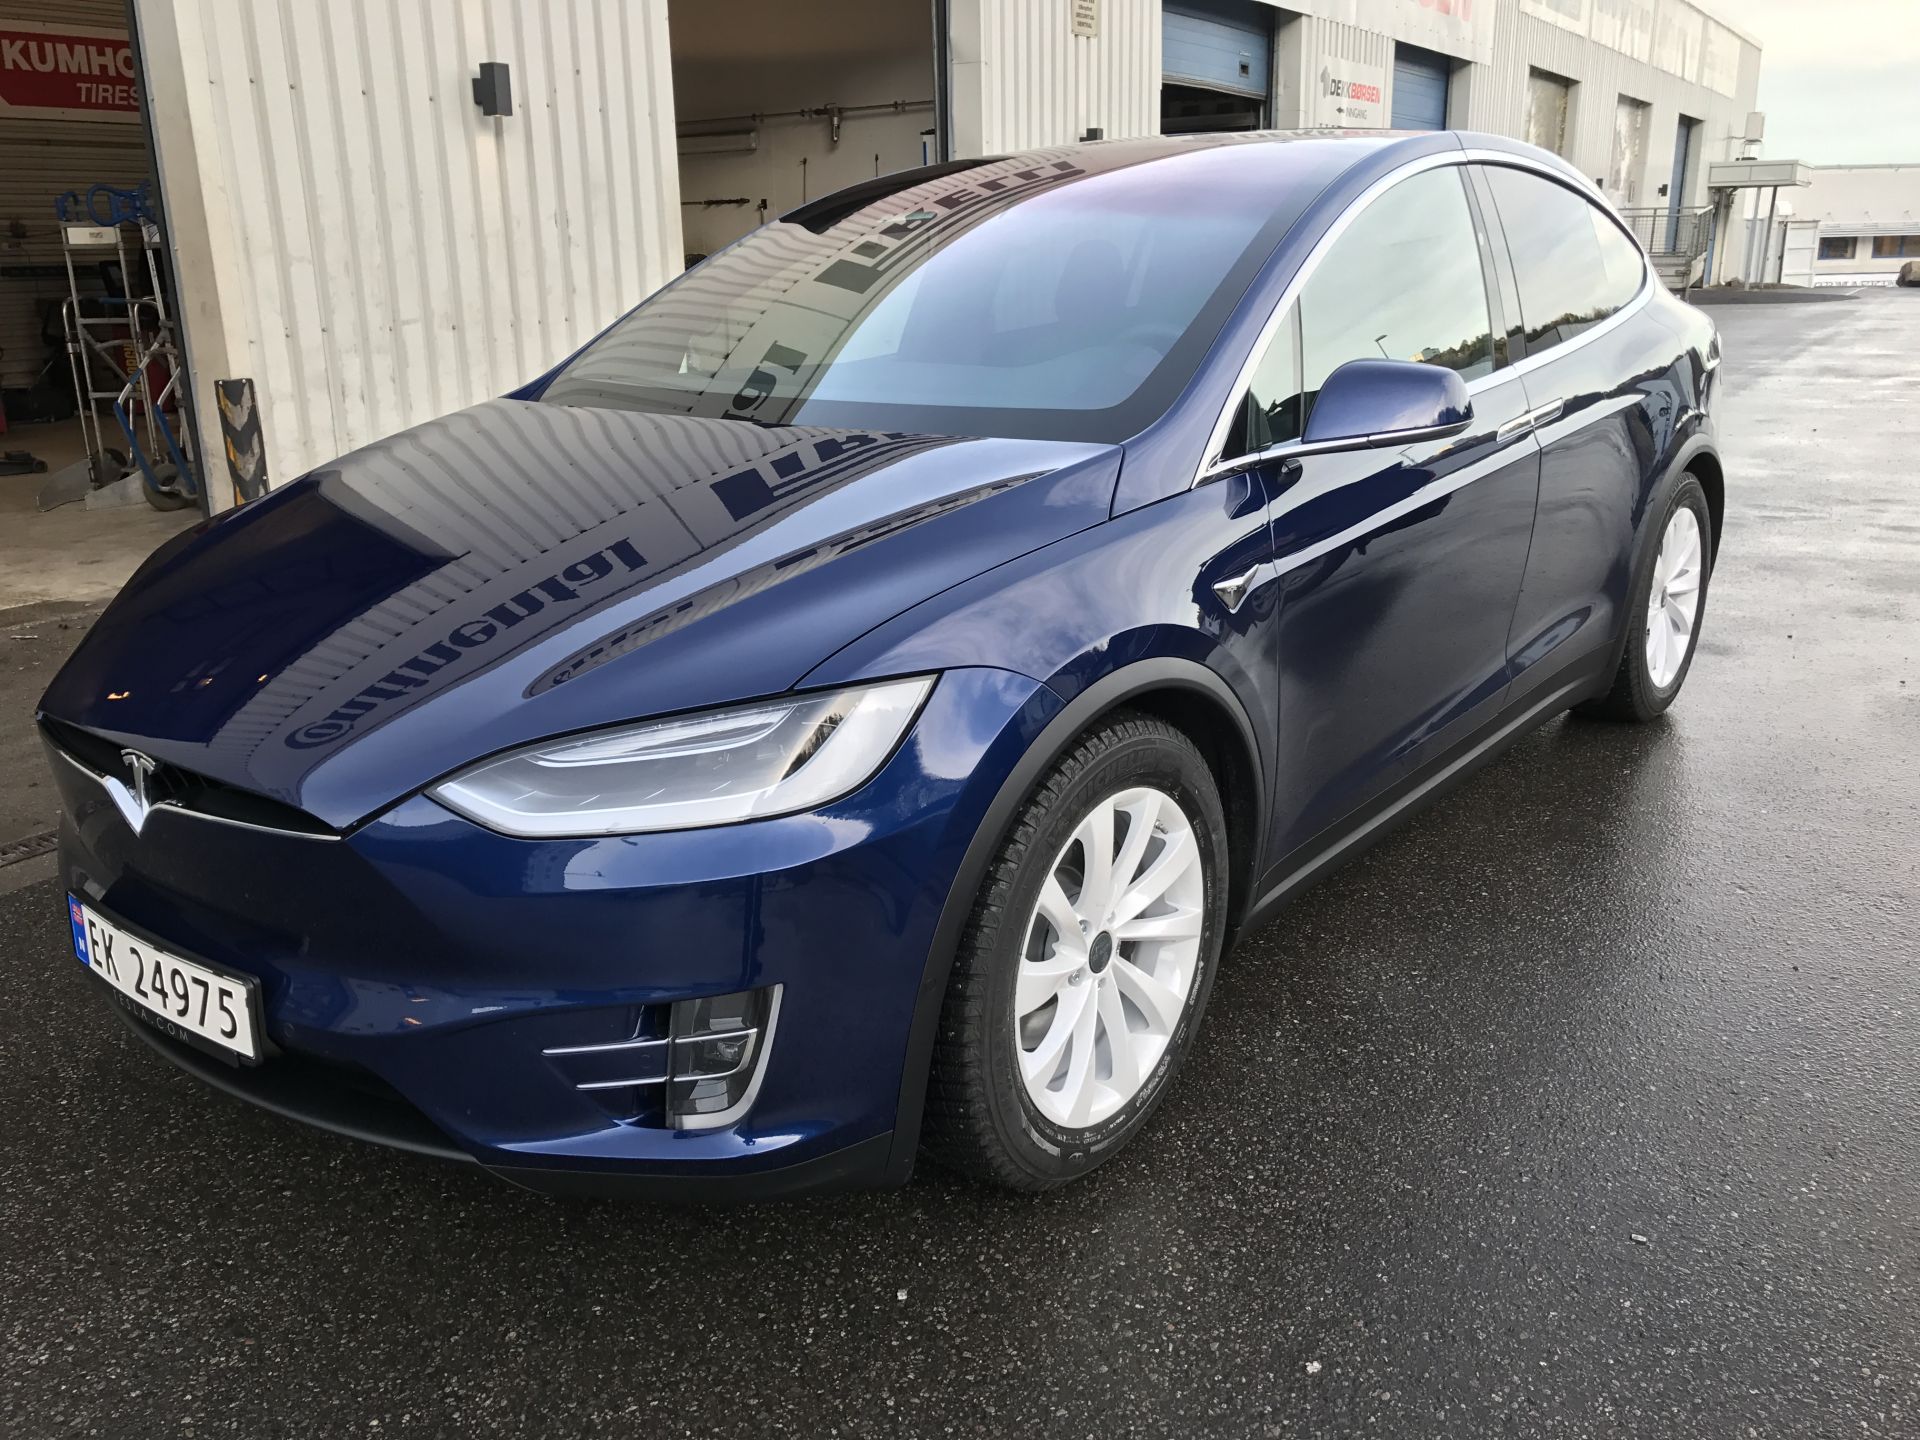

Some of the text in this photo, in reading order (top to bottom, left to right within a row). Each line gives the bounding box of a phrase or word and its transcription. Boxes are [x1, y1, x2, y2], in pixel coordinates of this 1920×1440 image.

[1, 39, 135, 79] KUMHO
[76, 83, 140, 105] TIRES
[78, 936, 86, 953] N
[87, 918, 238, 1039] EK 24975
